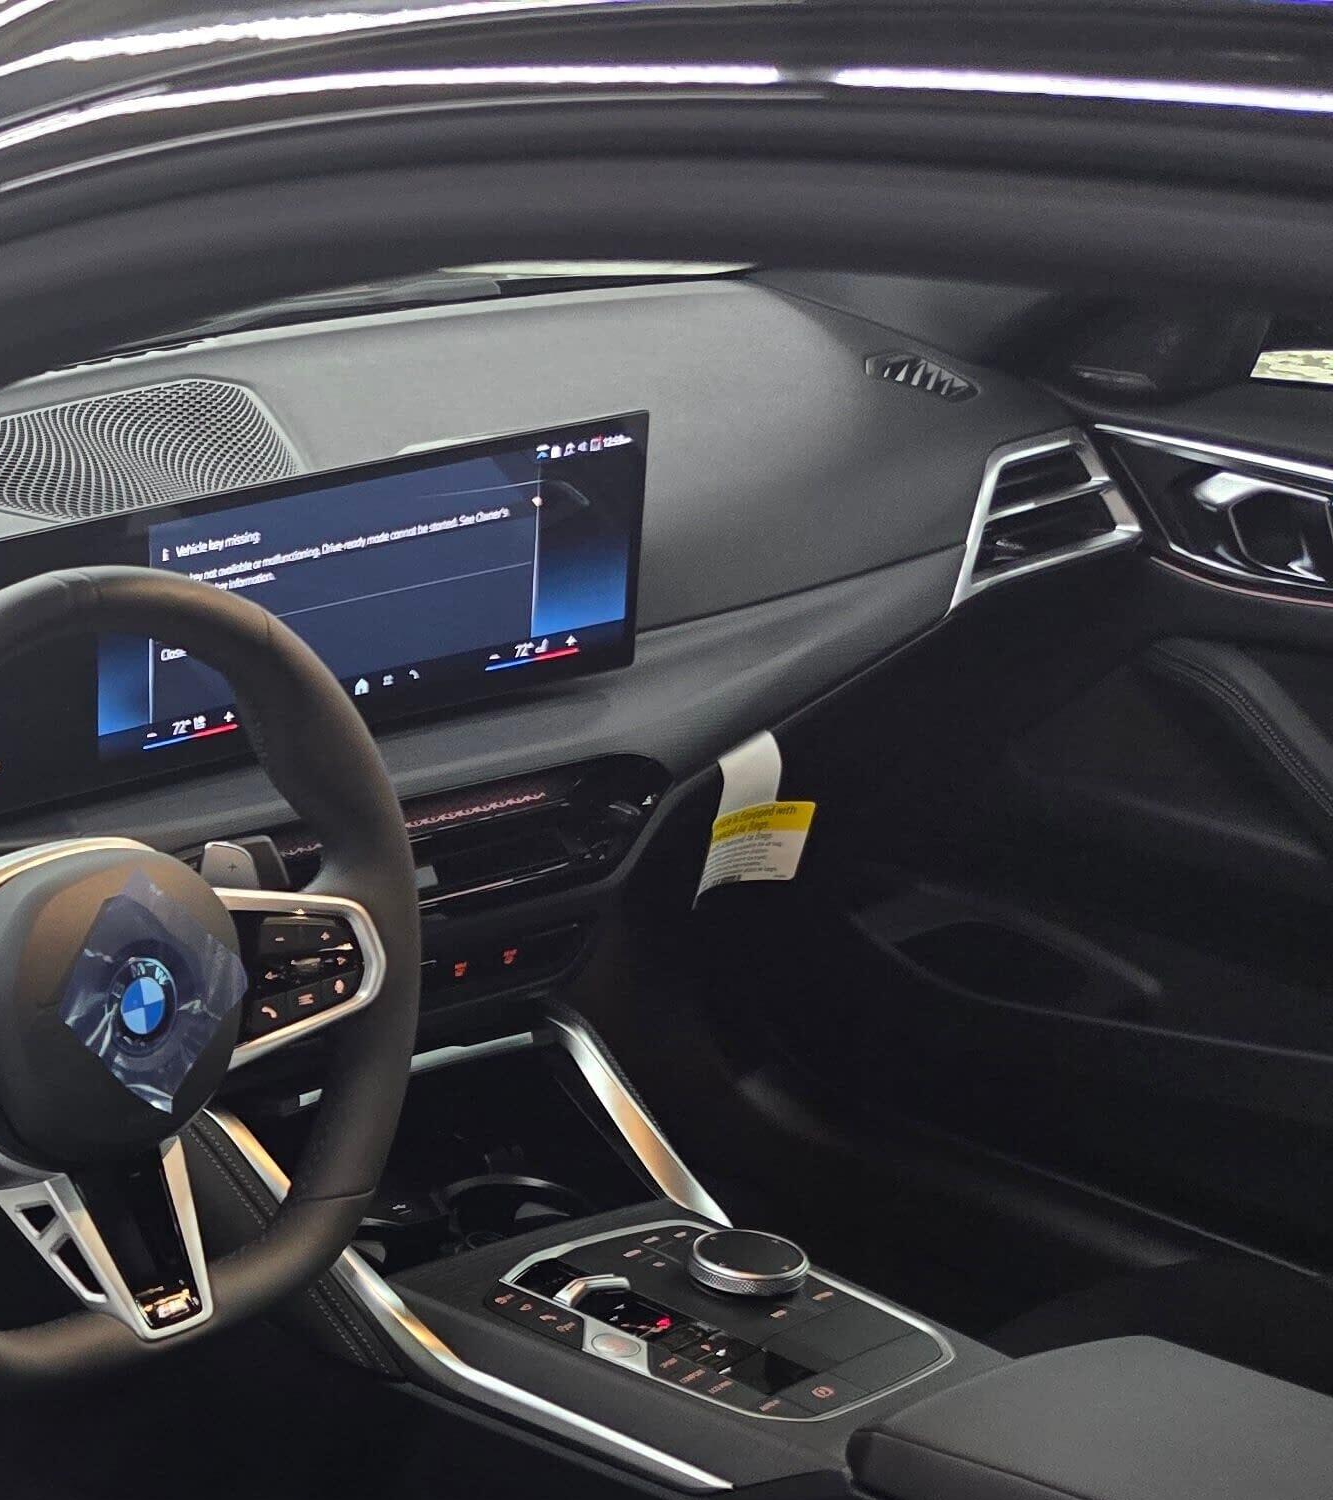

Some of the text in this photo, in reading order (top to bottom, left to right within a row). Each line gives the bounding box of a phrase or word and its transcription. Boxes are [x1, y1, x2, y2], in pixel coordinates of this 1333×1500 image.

[175, 542, 208, 558] Vehicle
[208, 539, 224, 552] key
[203, 570, 218, 580] not
[217, 561, 253, 579] available
[367, 531, 390, 545] mode
[390, 526, 417, 542] cannot
[459, 514, 476, 526] See
[475, 507, 511, 524] Owner's
